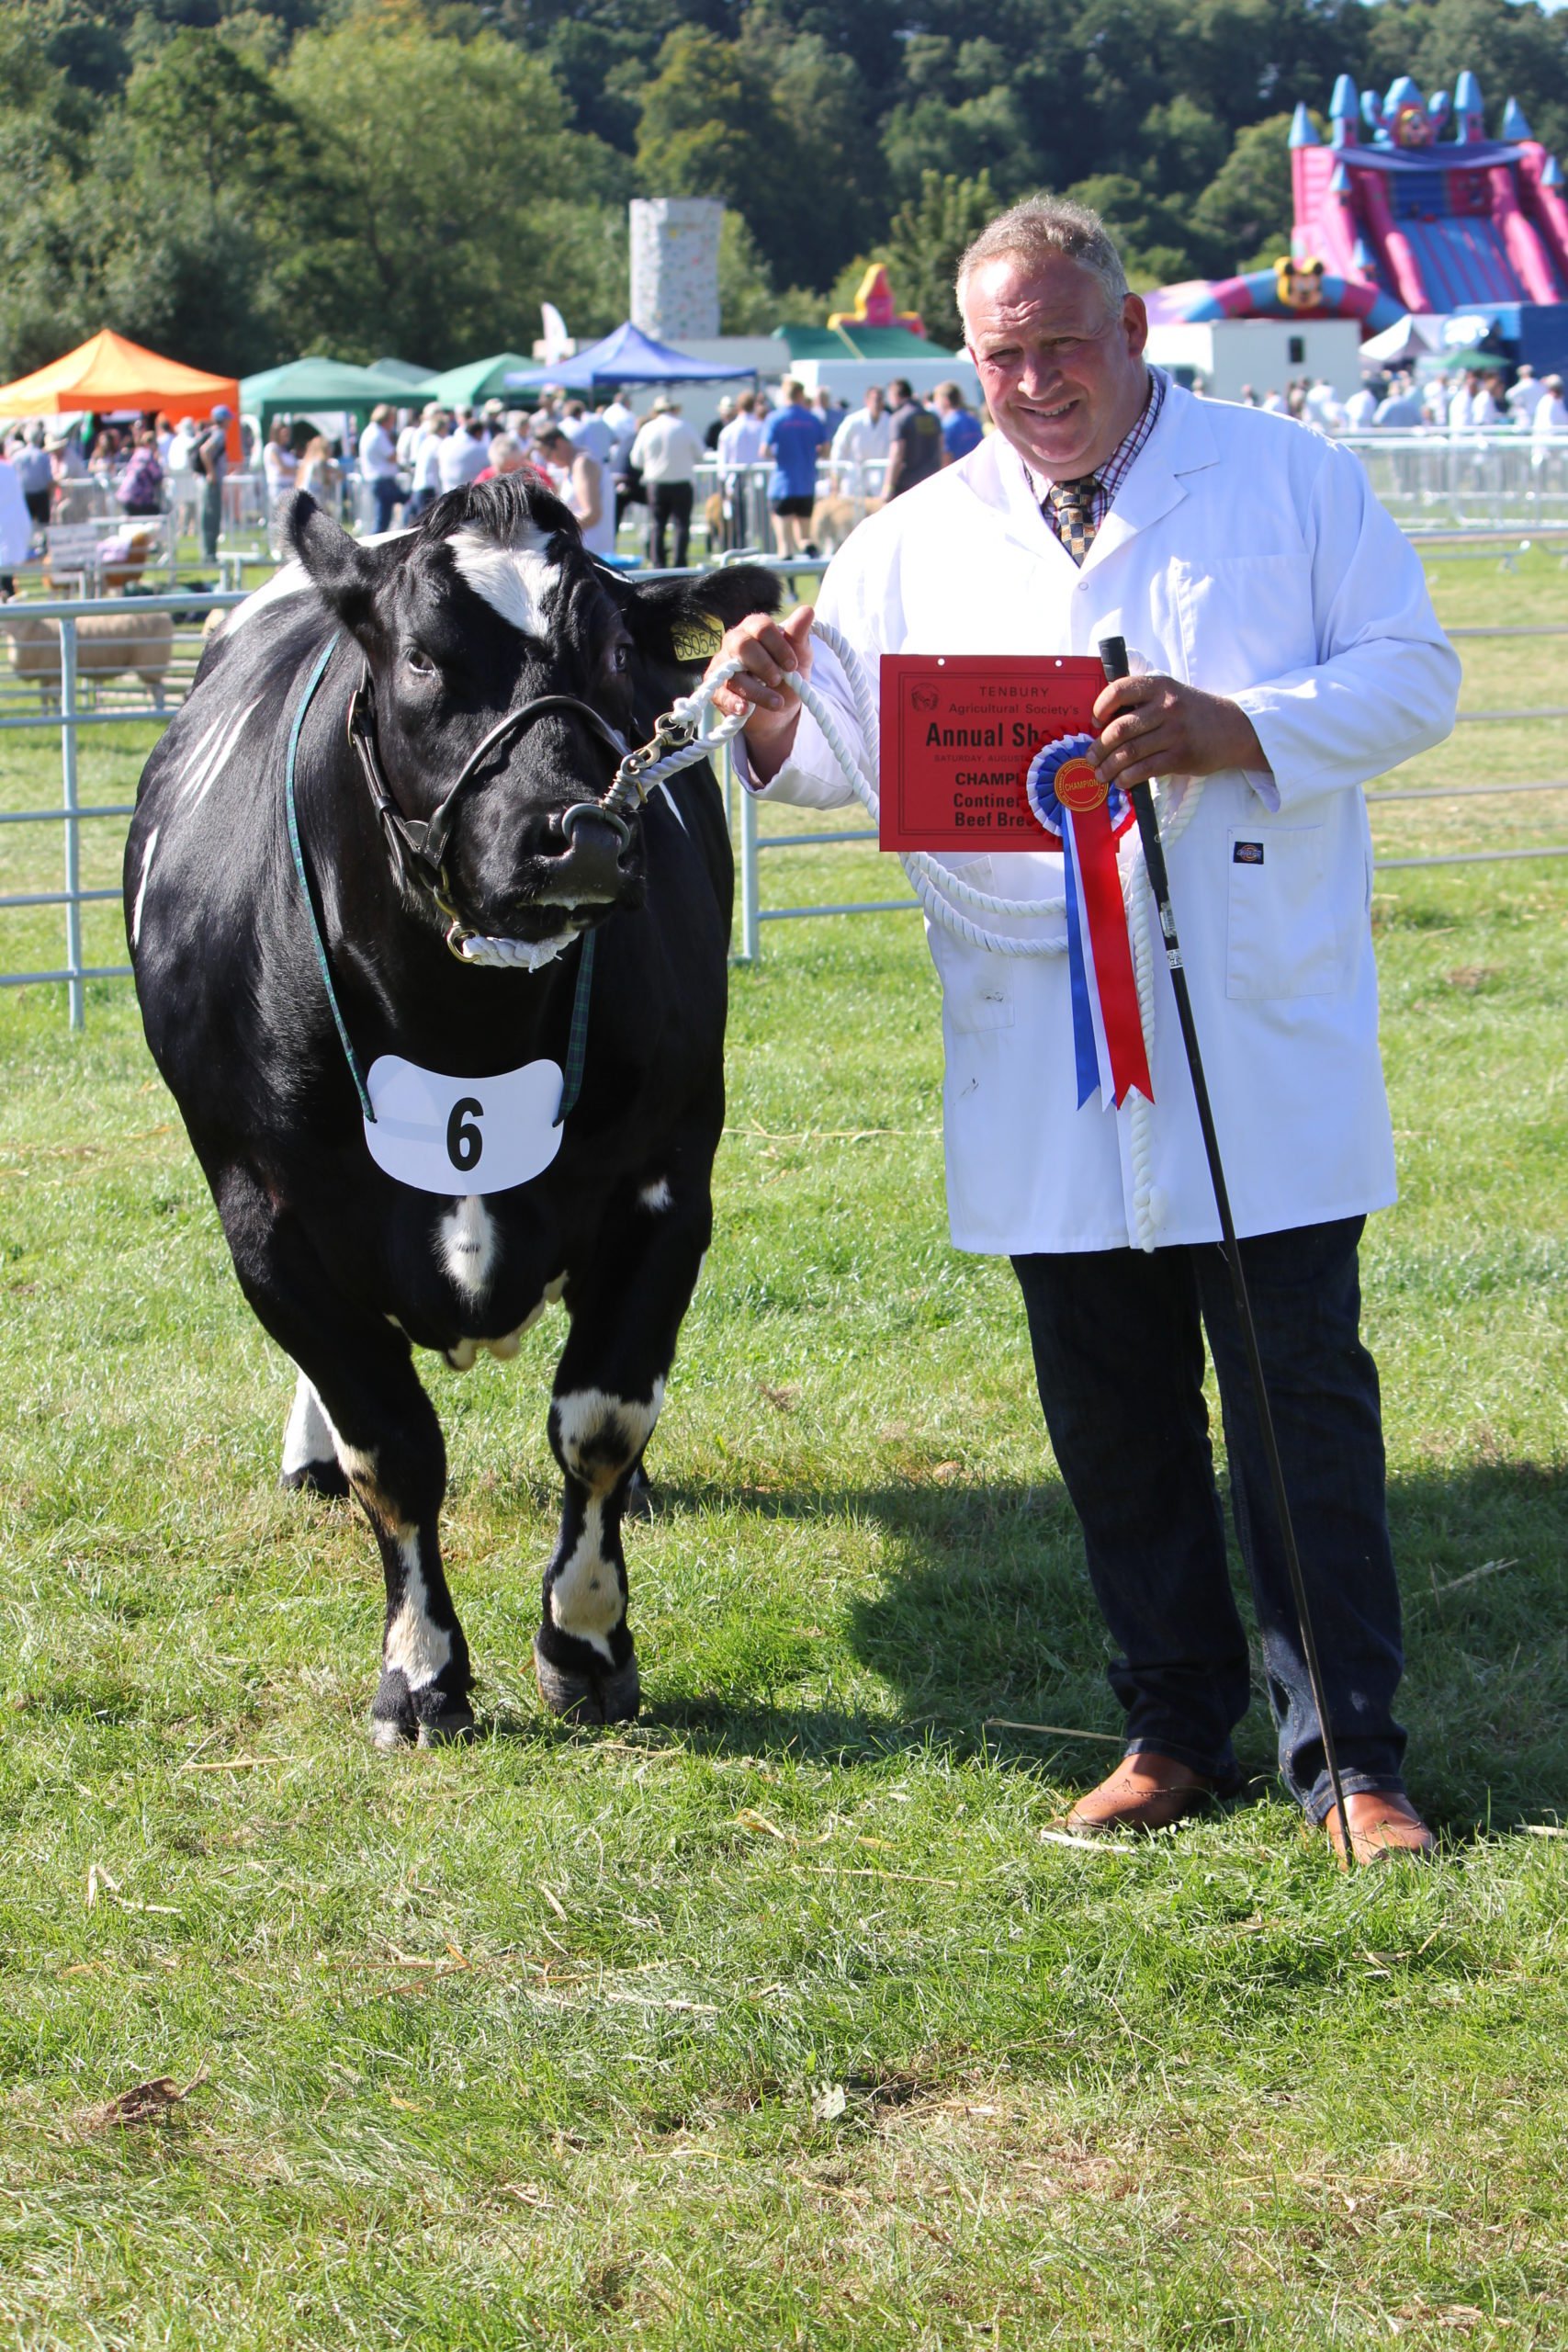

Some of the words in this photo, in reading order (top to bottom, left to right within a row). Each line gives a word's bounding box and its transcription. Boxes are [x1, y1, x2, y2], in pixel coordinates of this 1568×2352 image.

[979, 686, 1050, 698] TENBURY
[949, 704, 1020, 716] Agricultural
[1025, 704, 1079, 717] Society's
[926, 722, 1003, 747] Annual
[1012, 722, 1049, 748] Sh
[934, 754, 985, 763] SATURDAY,
[987, 754, 1025, 763] AUGUST
[955, 773, 1020, 786] CHAMPI
[1065, 778, 1100, 792] CHAMPION
[953, 793, 1020, 808] Contine
[955, 811, 992, 827] Beef
[998, 811, 1032, 827] Bre
[446, 1097, 484, 1171] 6
